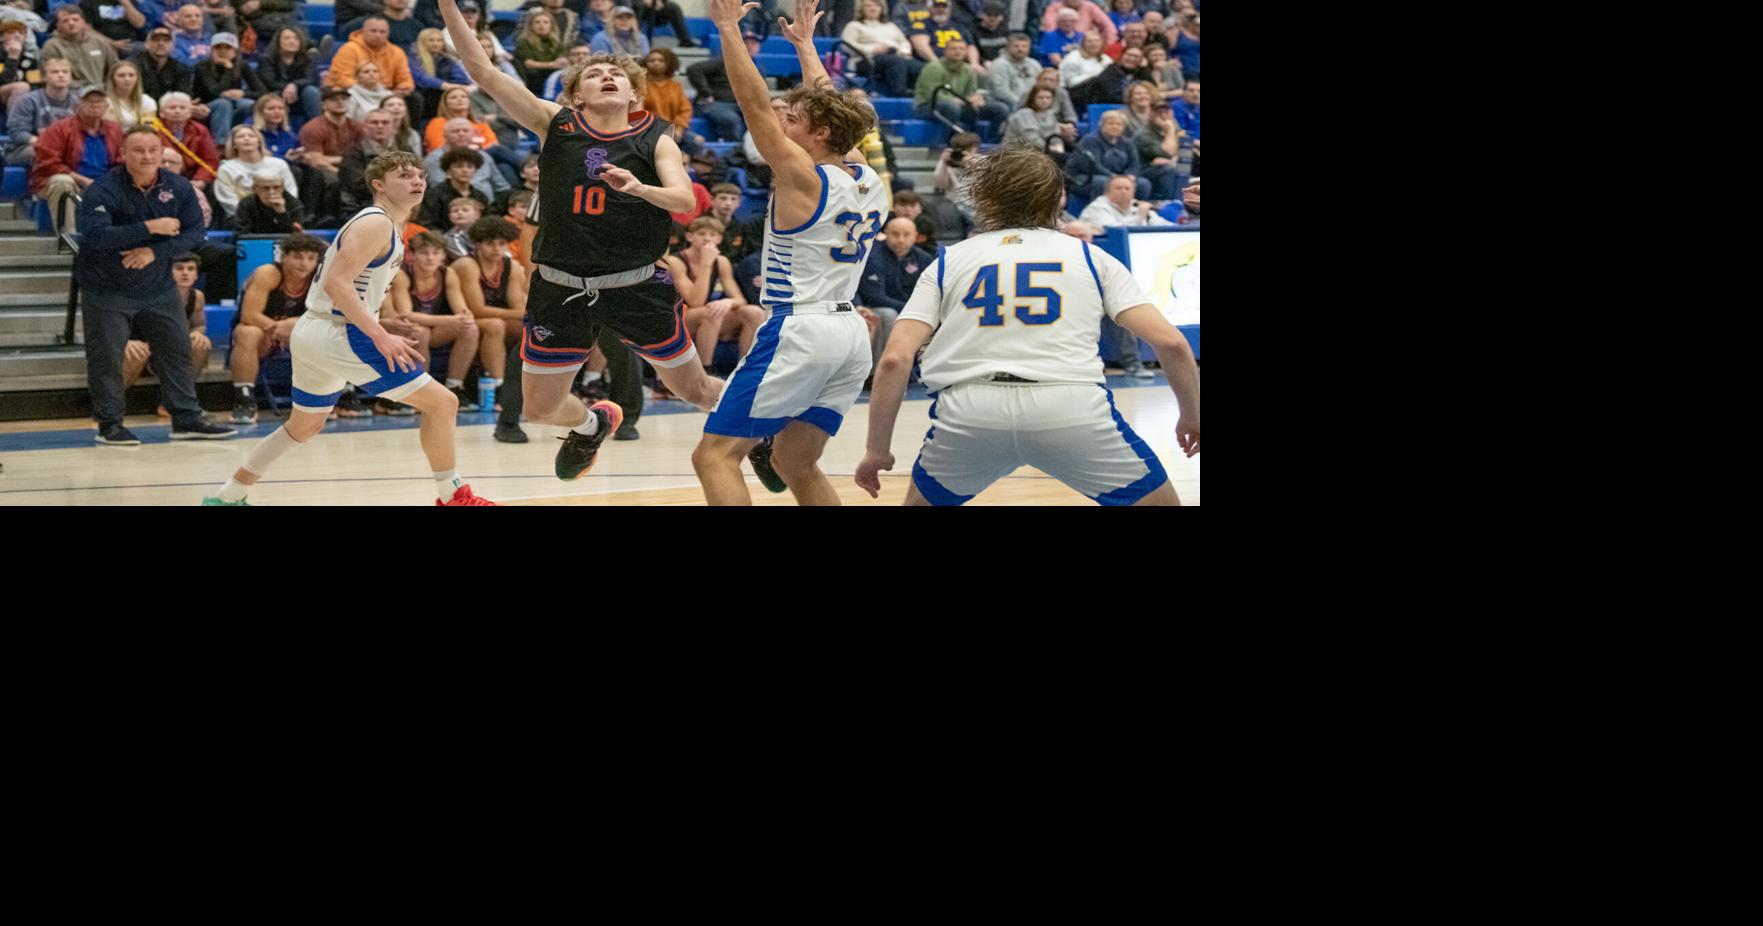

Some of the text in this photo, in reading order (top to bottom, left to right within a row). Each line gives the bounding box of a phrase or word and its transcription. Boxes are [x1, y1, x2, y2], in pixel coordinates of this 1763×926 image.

[572, 185, 606, 215] 10
[830, 209, 882, 264] 32
[961, 261, 1063, 327] 45
